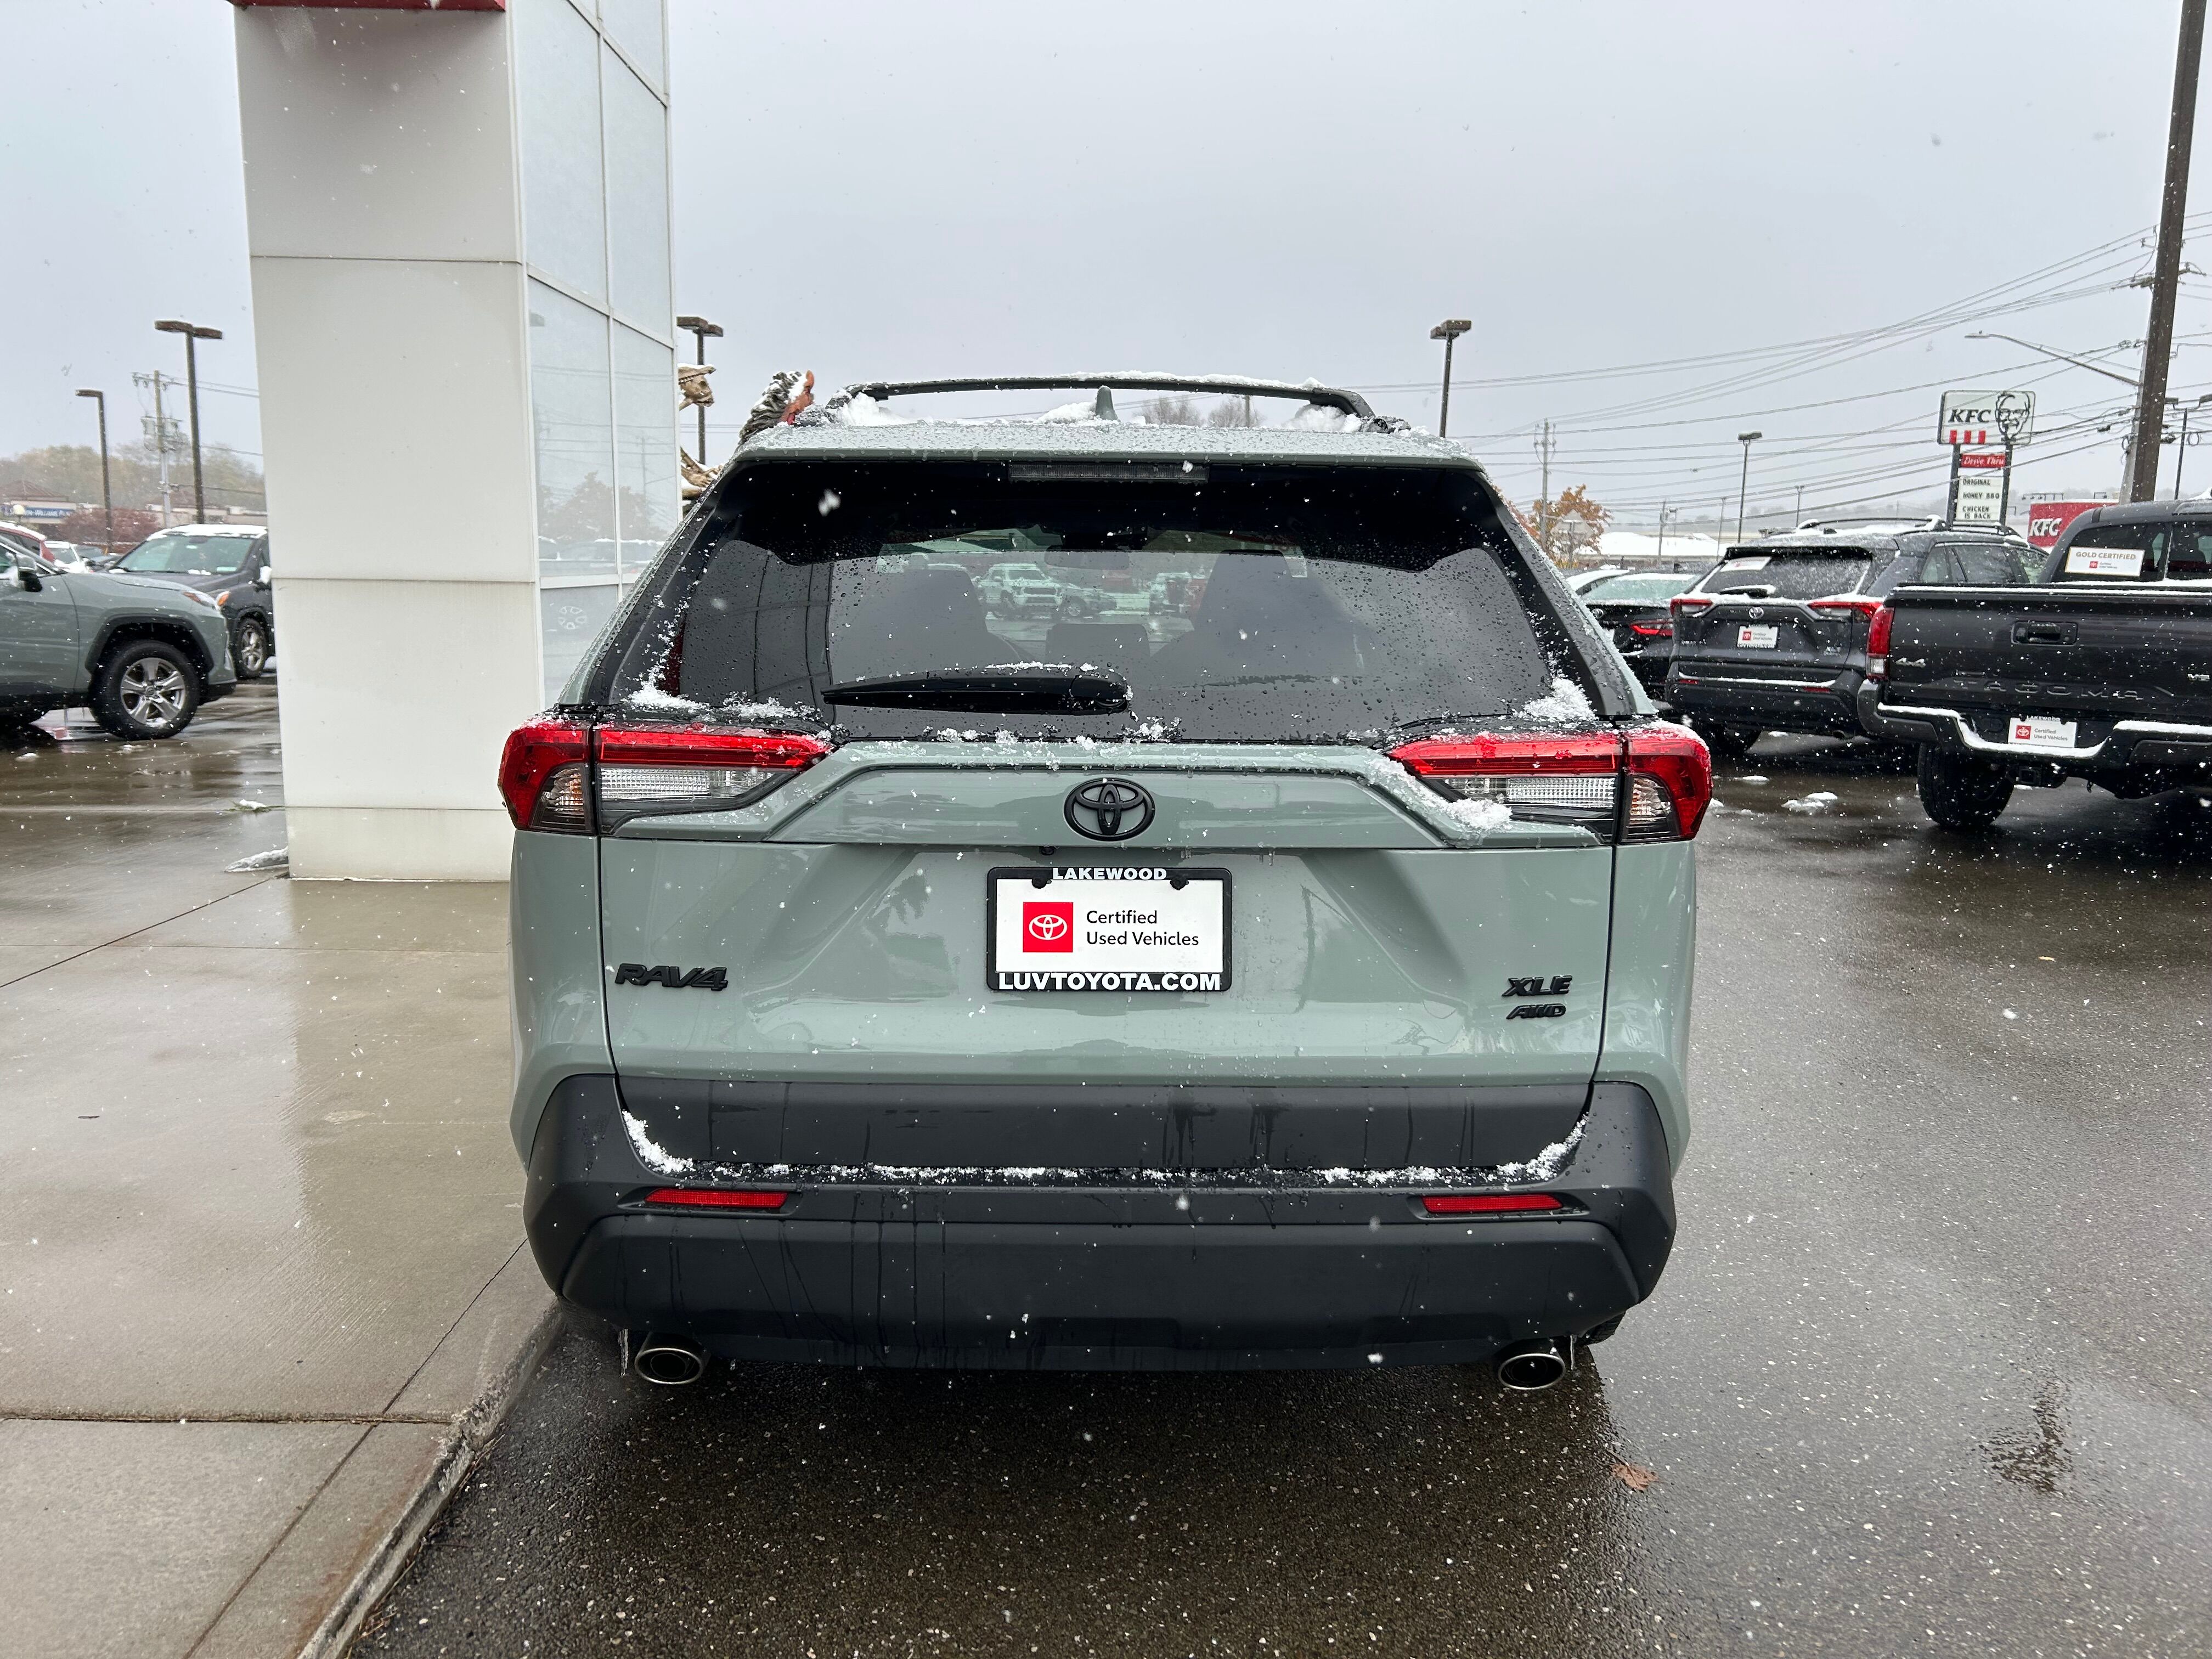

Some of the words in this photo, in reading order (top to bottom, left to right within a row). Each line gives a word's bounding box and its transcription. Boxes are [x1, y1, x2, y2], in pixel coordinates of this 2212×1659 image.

[1948, 409, 1991, 422] KFC
[1963, 456, 1984, 465] Drive
[2029, 518, 2062, 537] KFC
[1053, 868, 1167, 880] LAKEWOOD
[1086, 910, 1157, 924] Certified
[1087, 932, 1127, 945] Used
[1132, 932, 1199, 945] Vehicles
[614, 963, 729, 991] RAV4
[998, 973, 1220, 990] LUVTOYOTA.COM
[1502, 975, 1572, 996] XLE
[1506, 1003, 1566, 1019] AWD
